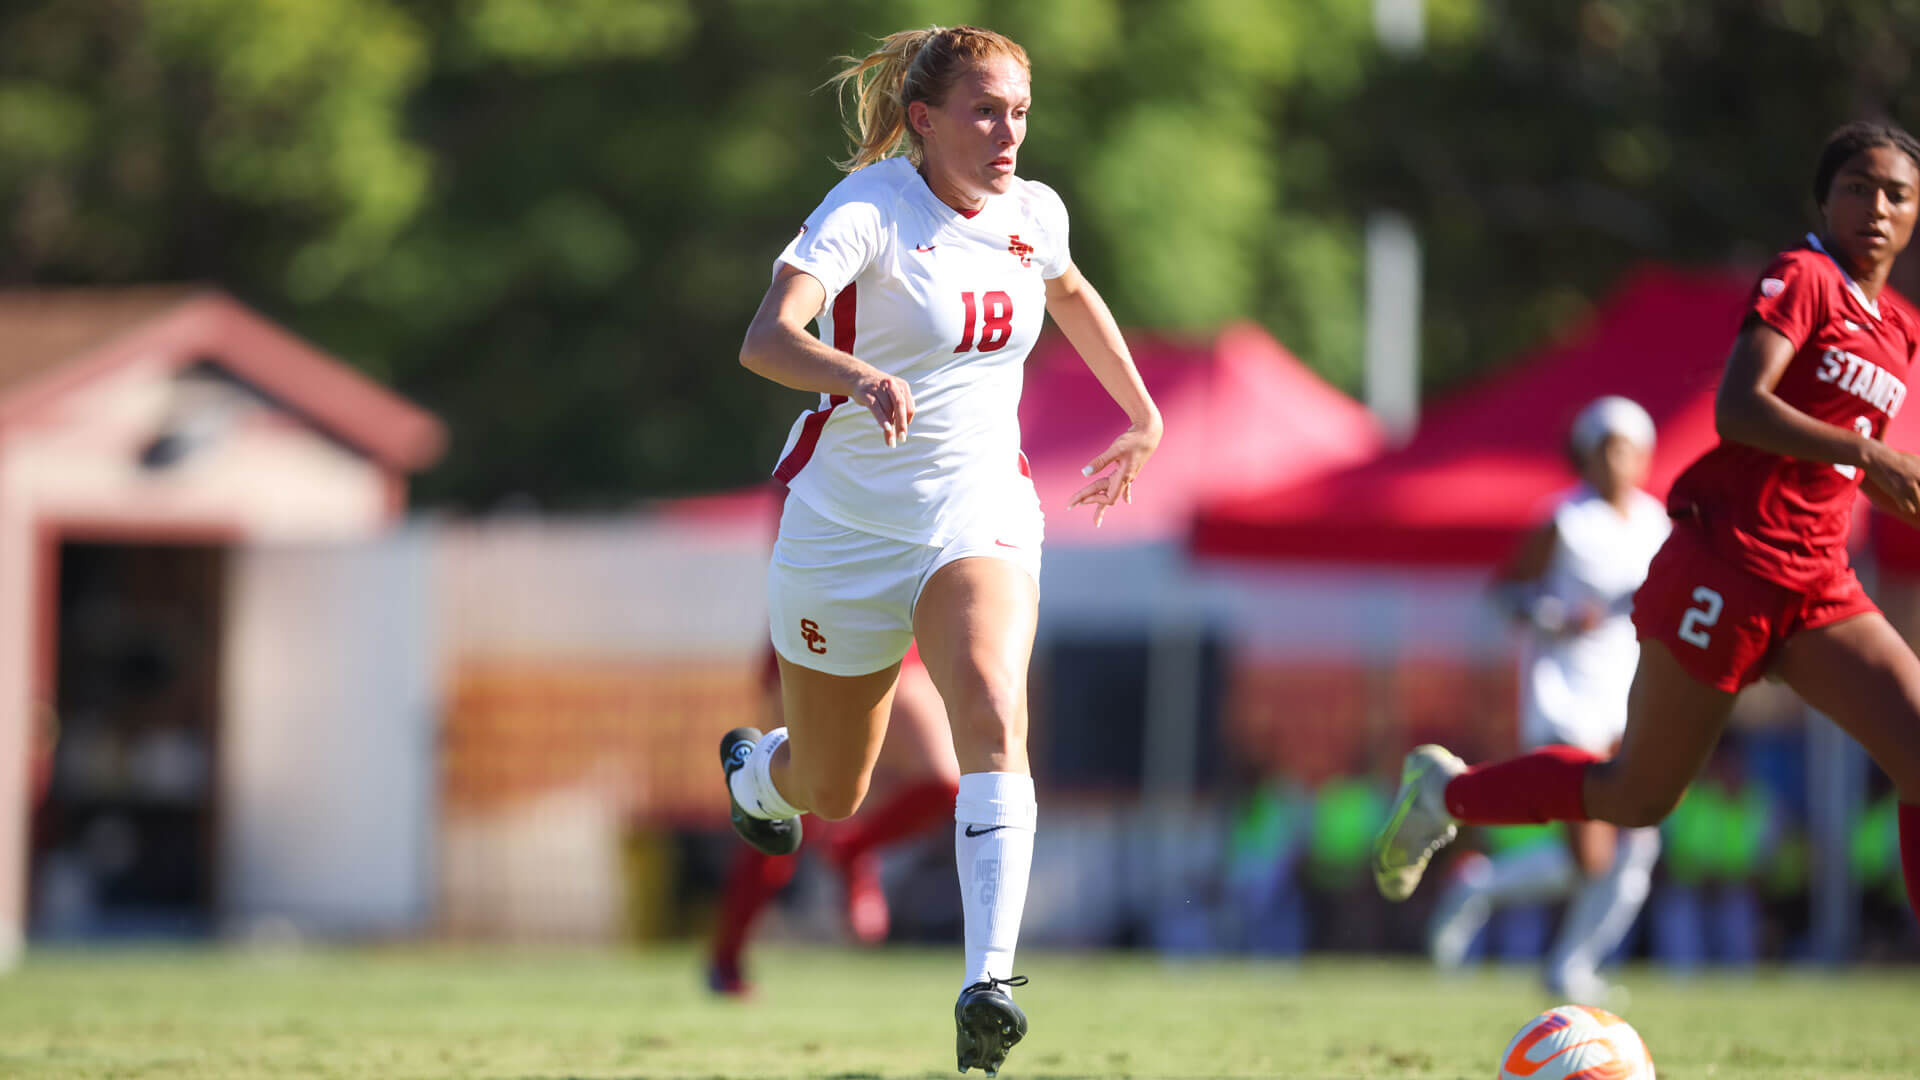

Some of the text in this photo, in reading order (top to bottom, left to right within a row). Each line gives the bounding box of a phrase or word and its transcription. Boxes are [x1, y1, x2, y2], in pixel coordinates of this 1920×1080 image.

[953, 291, 1013, 353] 18
[800, 618, 827, 655] SC
[1678, 586, 1724, 649] 2
